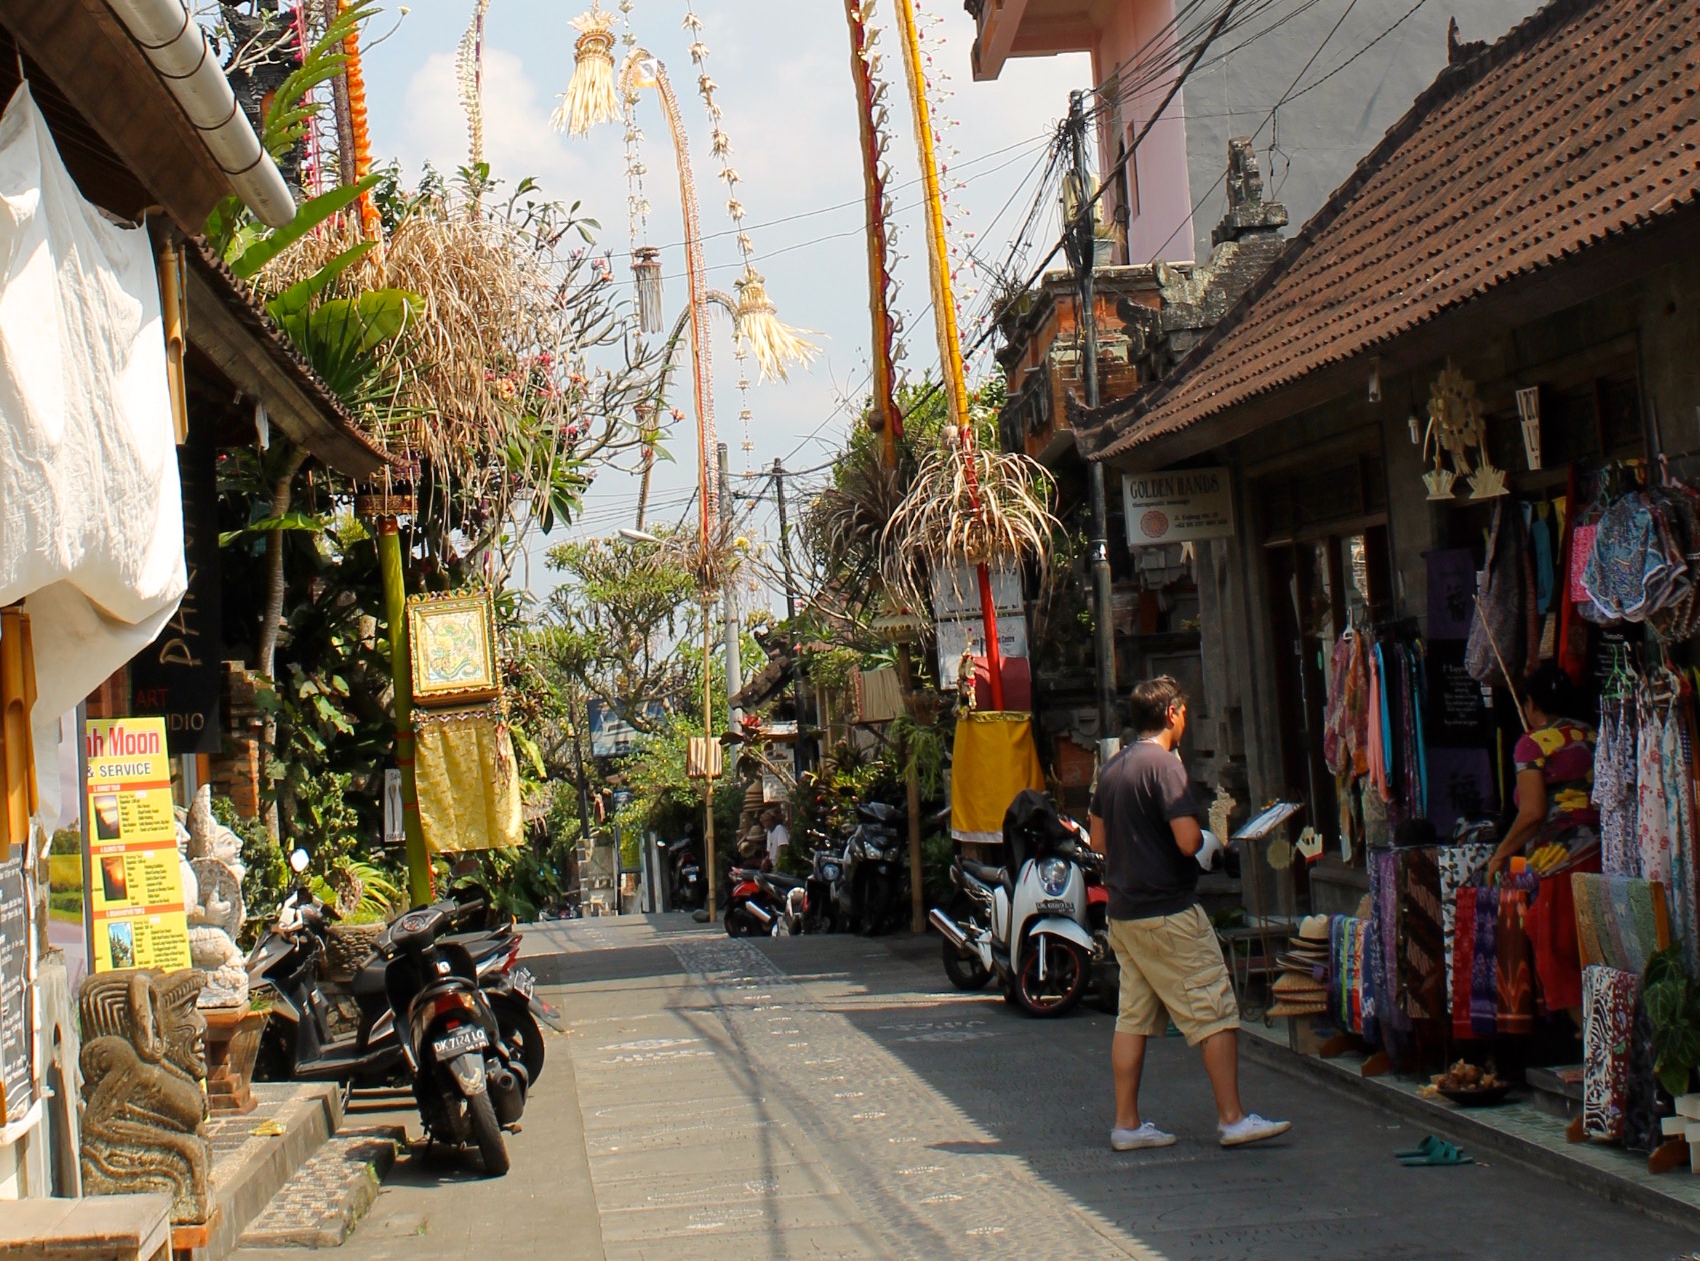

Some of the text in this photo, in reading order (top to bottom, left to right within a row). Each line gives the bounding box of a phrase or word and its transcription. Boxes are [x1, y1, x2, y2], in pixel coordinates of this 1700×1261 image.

[1130, 478, 1174, 498] GOLDEN
[135, 688, 168, 709] ART
[166, 713, 205, 731] DIO
[109, 726, 160, 756] Moon
[99, 763, 151, 777] SERVICE
[434, 1039, 448, 1052] DK
